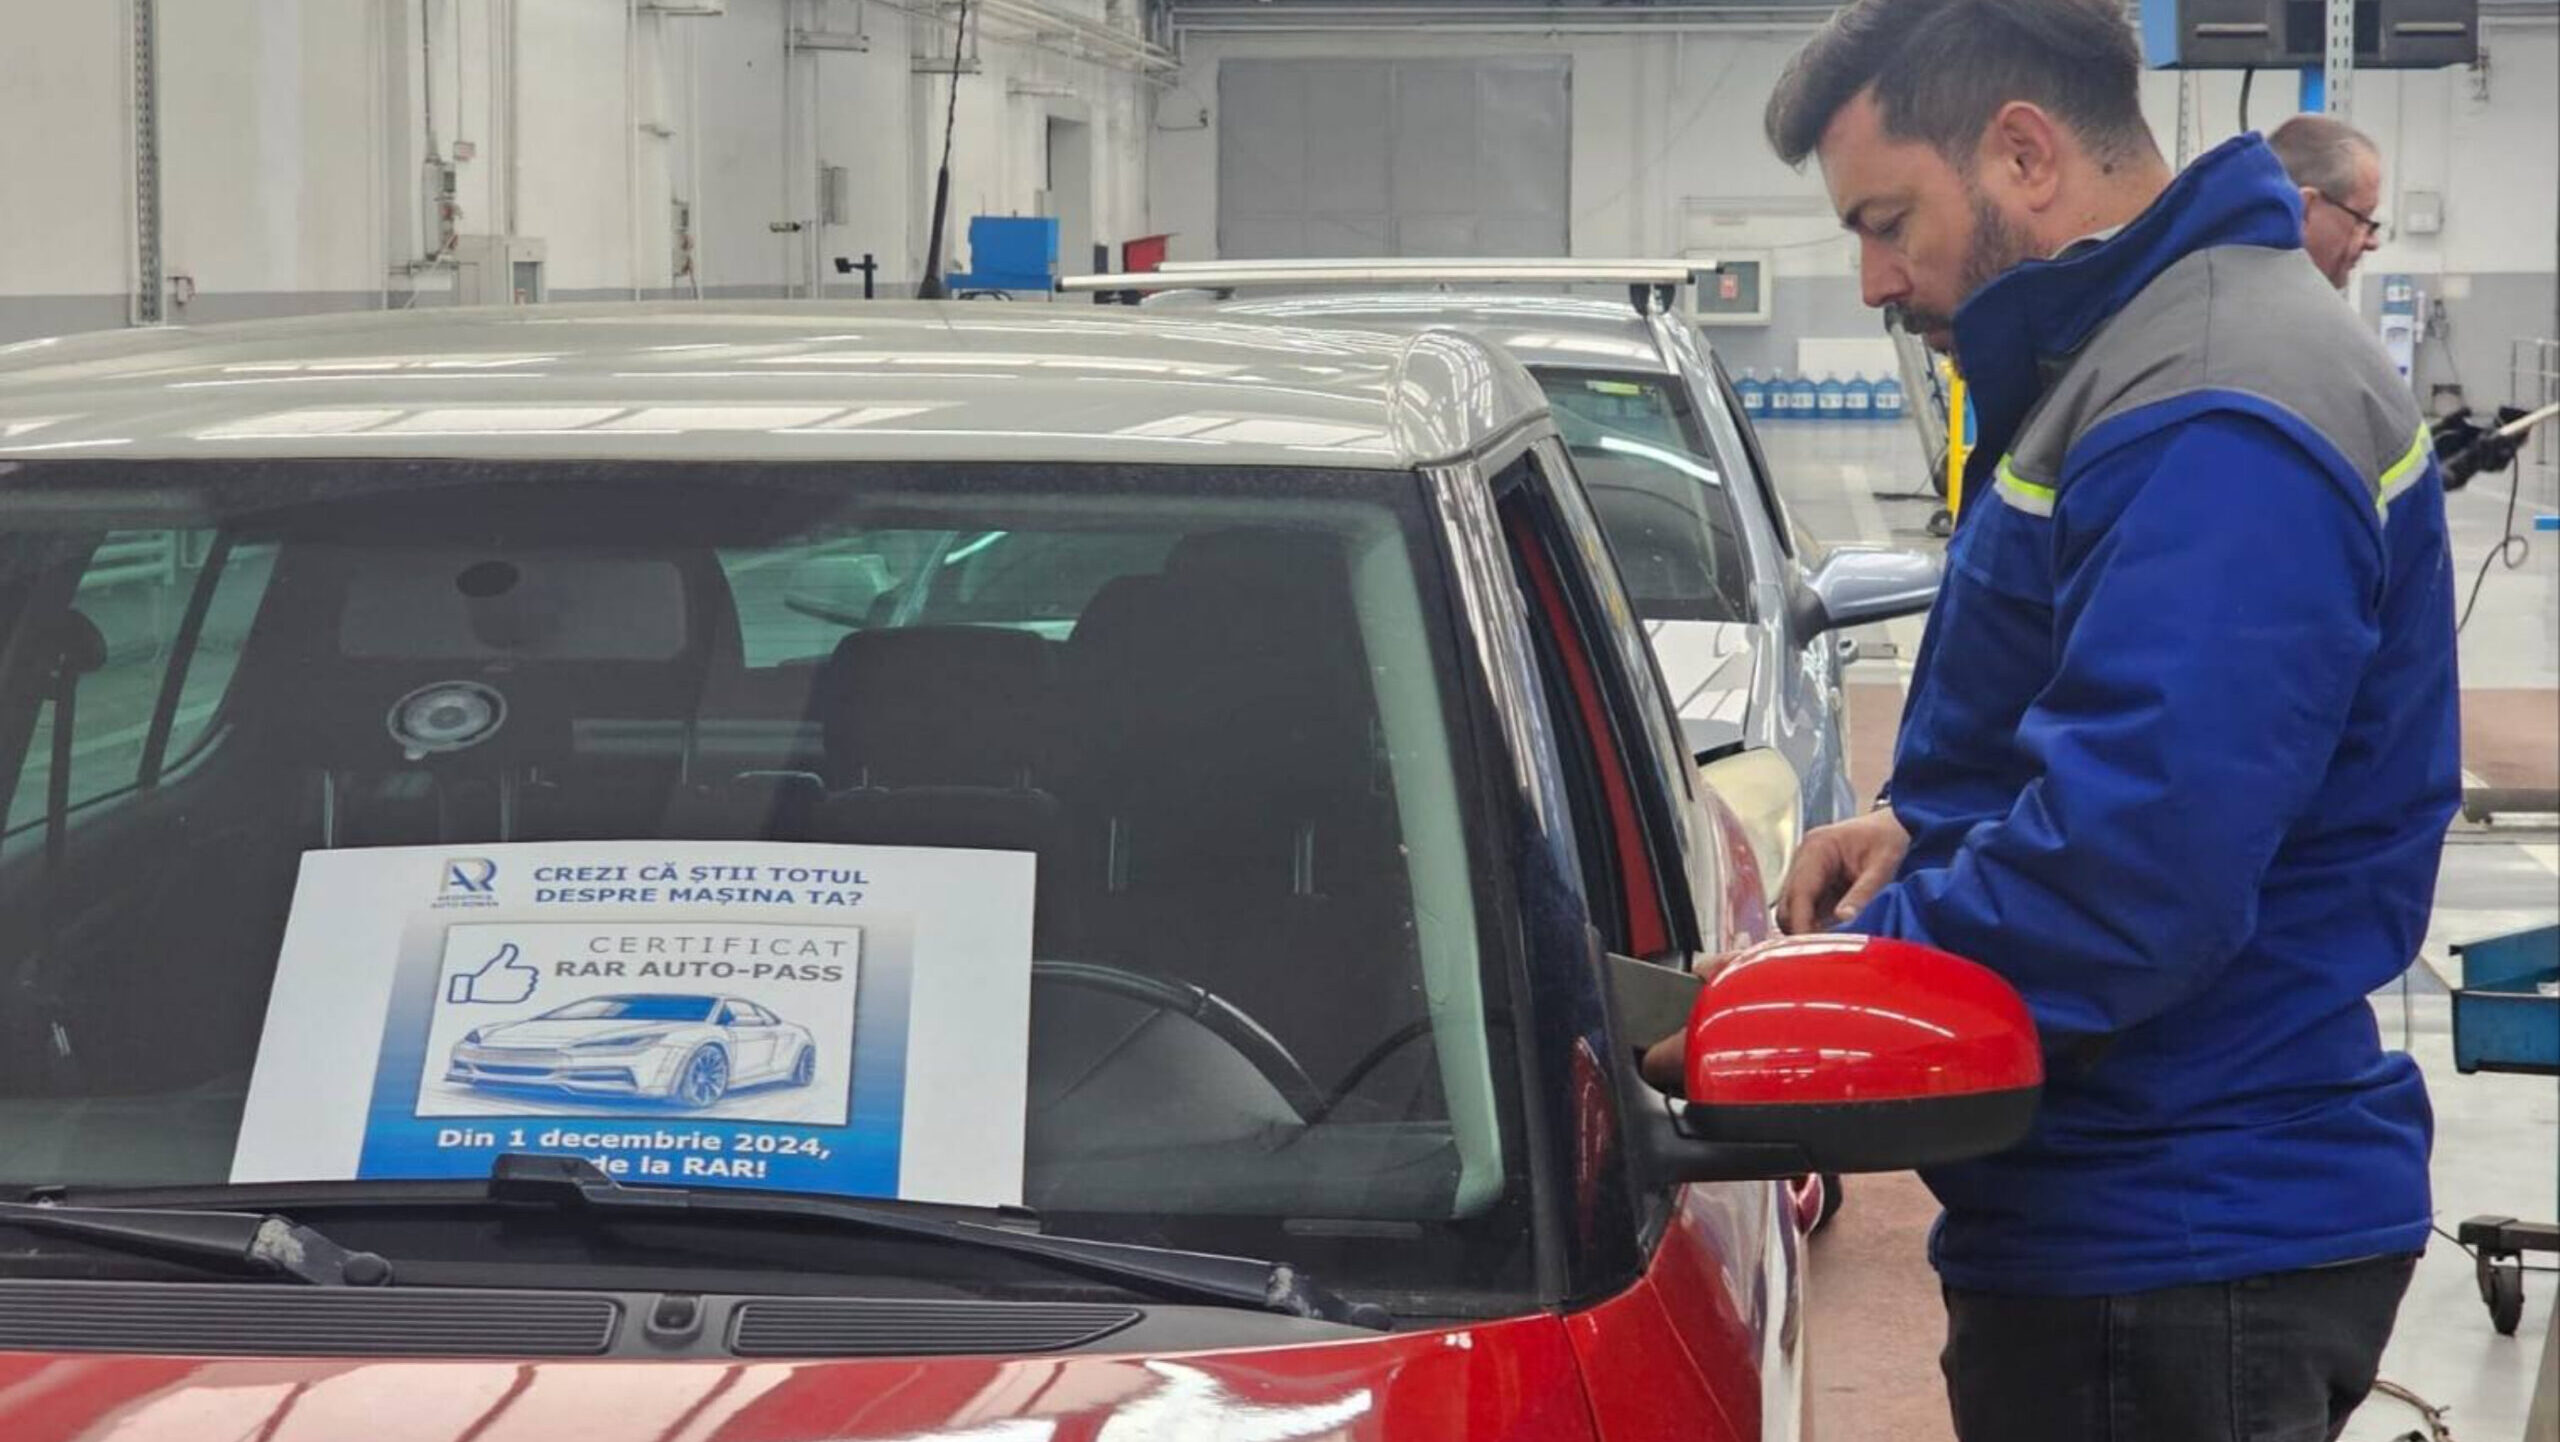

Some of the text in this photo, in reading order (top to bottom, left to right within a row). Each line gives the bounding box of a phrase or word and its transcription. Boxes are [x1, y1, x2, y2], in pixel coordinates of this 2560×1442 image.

[534, 866, 627, 882] CREZI
[638, 862, 679, 882] CĂ
[768, 867, 870, 885] TOTUL
[535, 887, 658, 903] DESPRE
[807, 890, 864, 906] TA?
[588, 936, 848, 957] CERTIFICAT
[555, 961, 844, 982] RAR AUTO-PASS
[437, 1128, 833, 1161] Din 1 decembrie 2024,
[640, 1156, 670, 1175] la
[682, 1157, 767, 1179] RAR!
